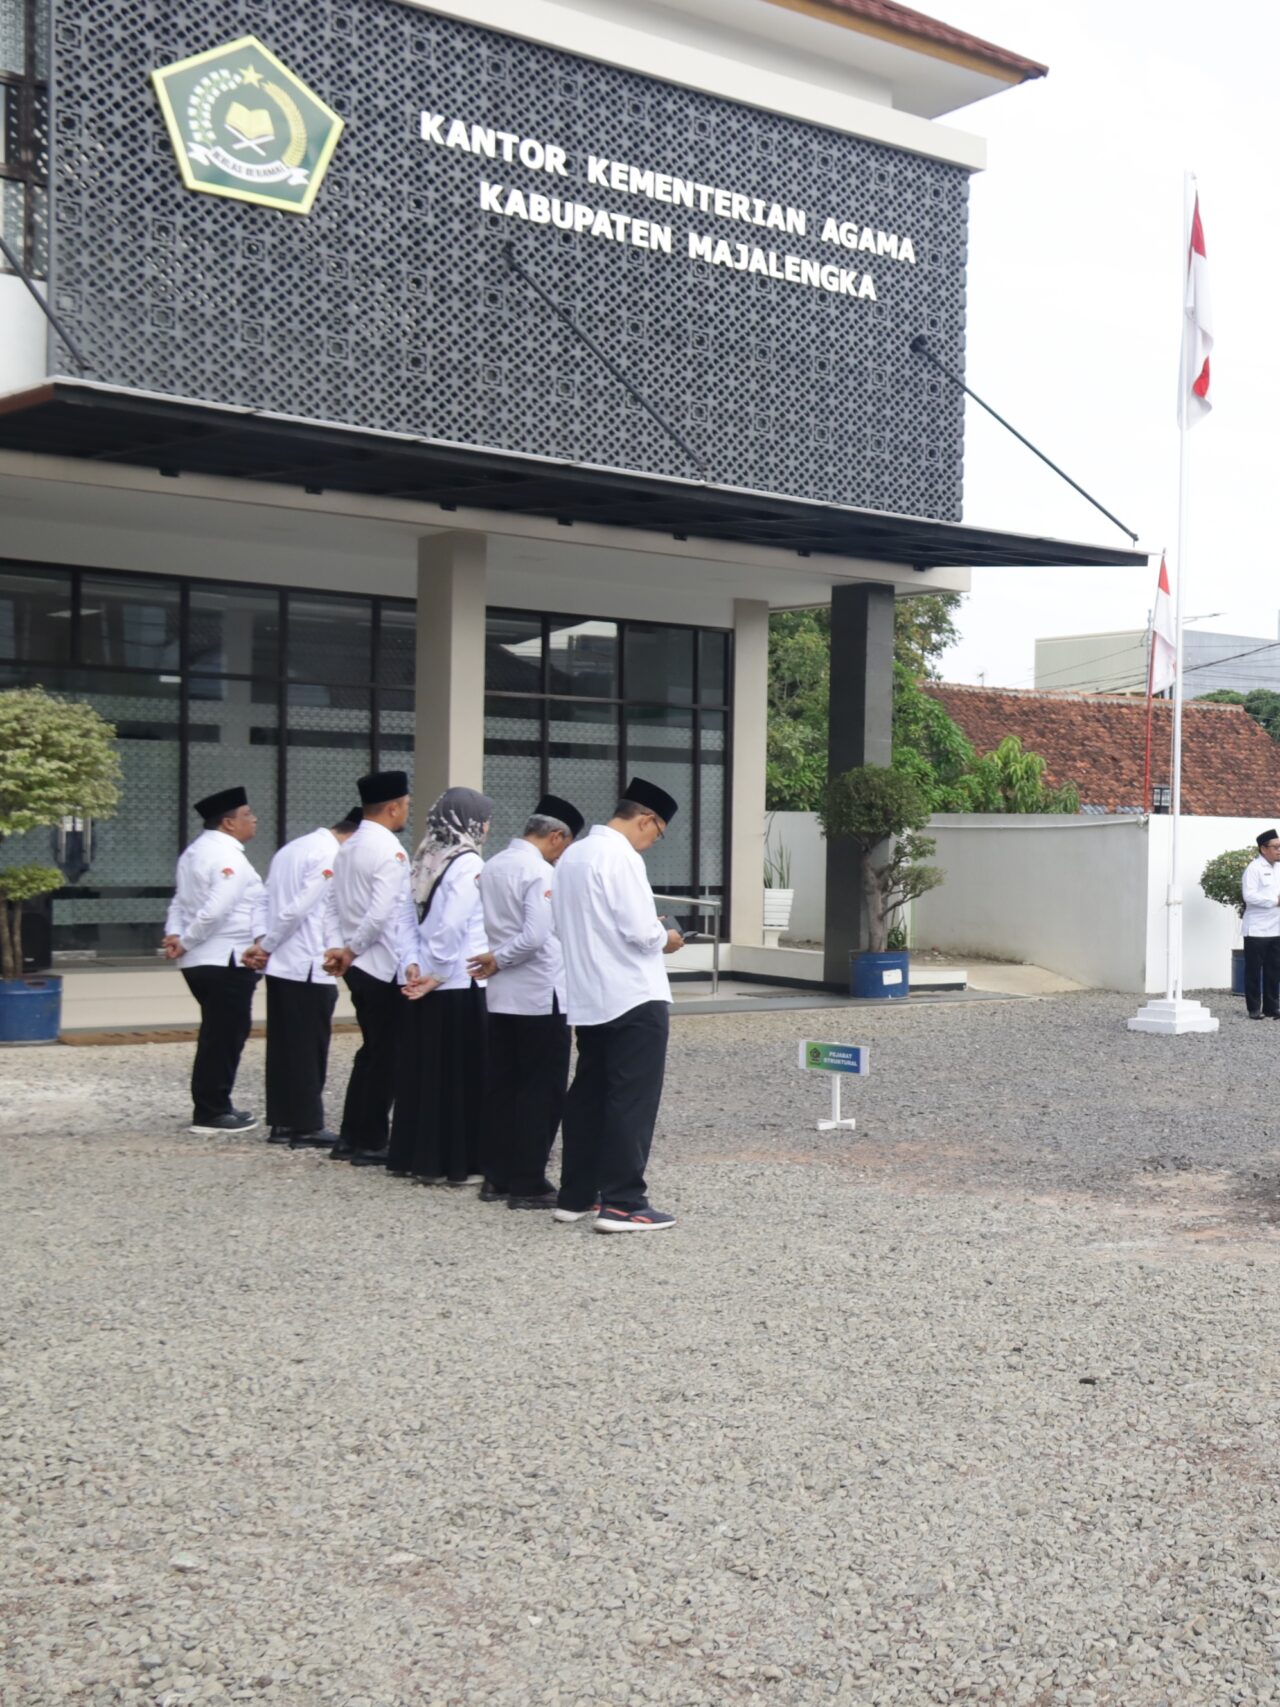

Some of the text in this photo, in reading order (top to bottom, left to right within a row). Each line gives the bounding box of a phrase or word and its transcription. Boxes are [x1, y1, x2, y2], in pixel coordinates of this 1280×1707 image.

[420, 111, 916, 264] KANTOR KEMENTERIAN AGAMA
[479, 181, 877, 301] KABUPATEN MAJALENGKA
